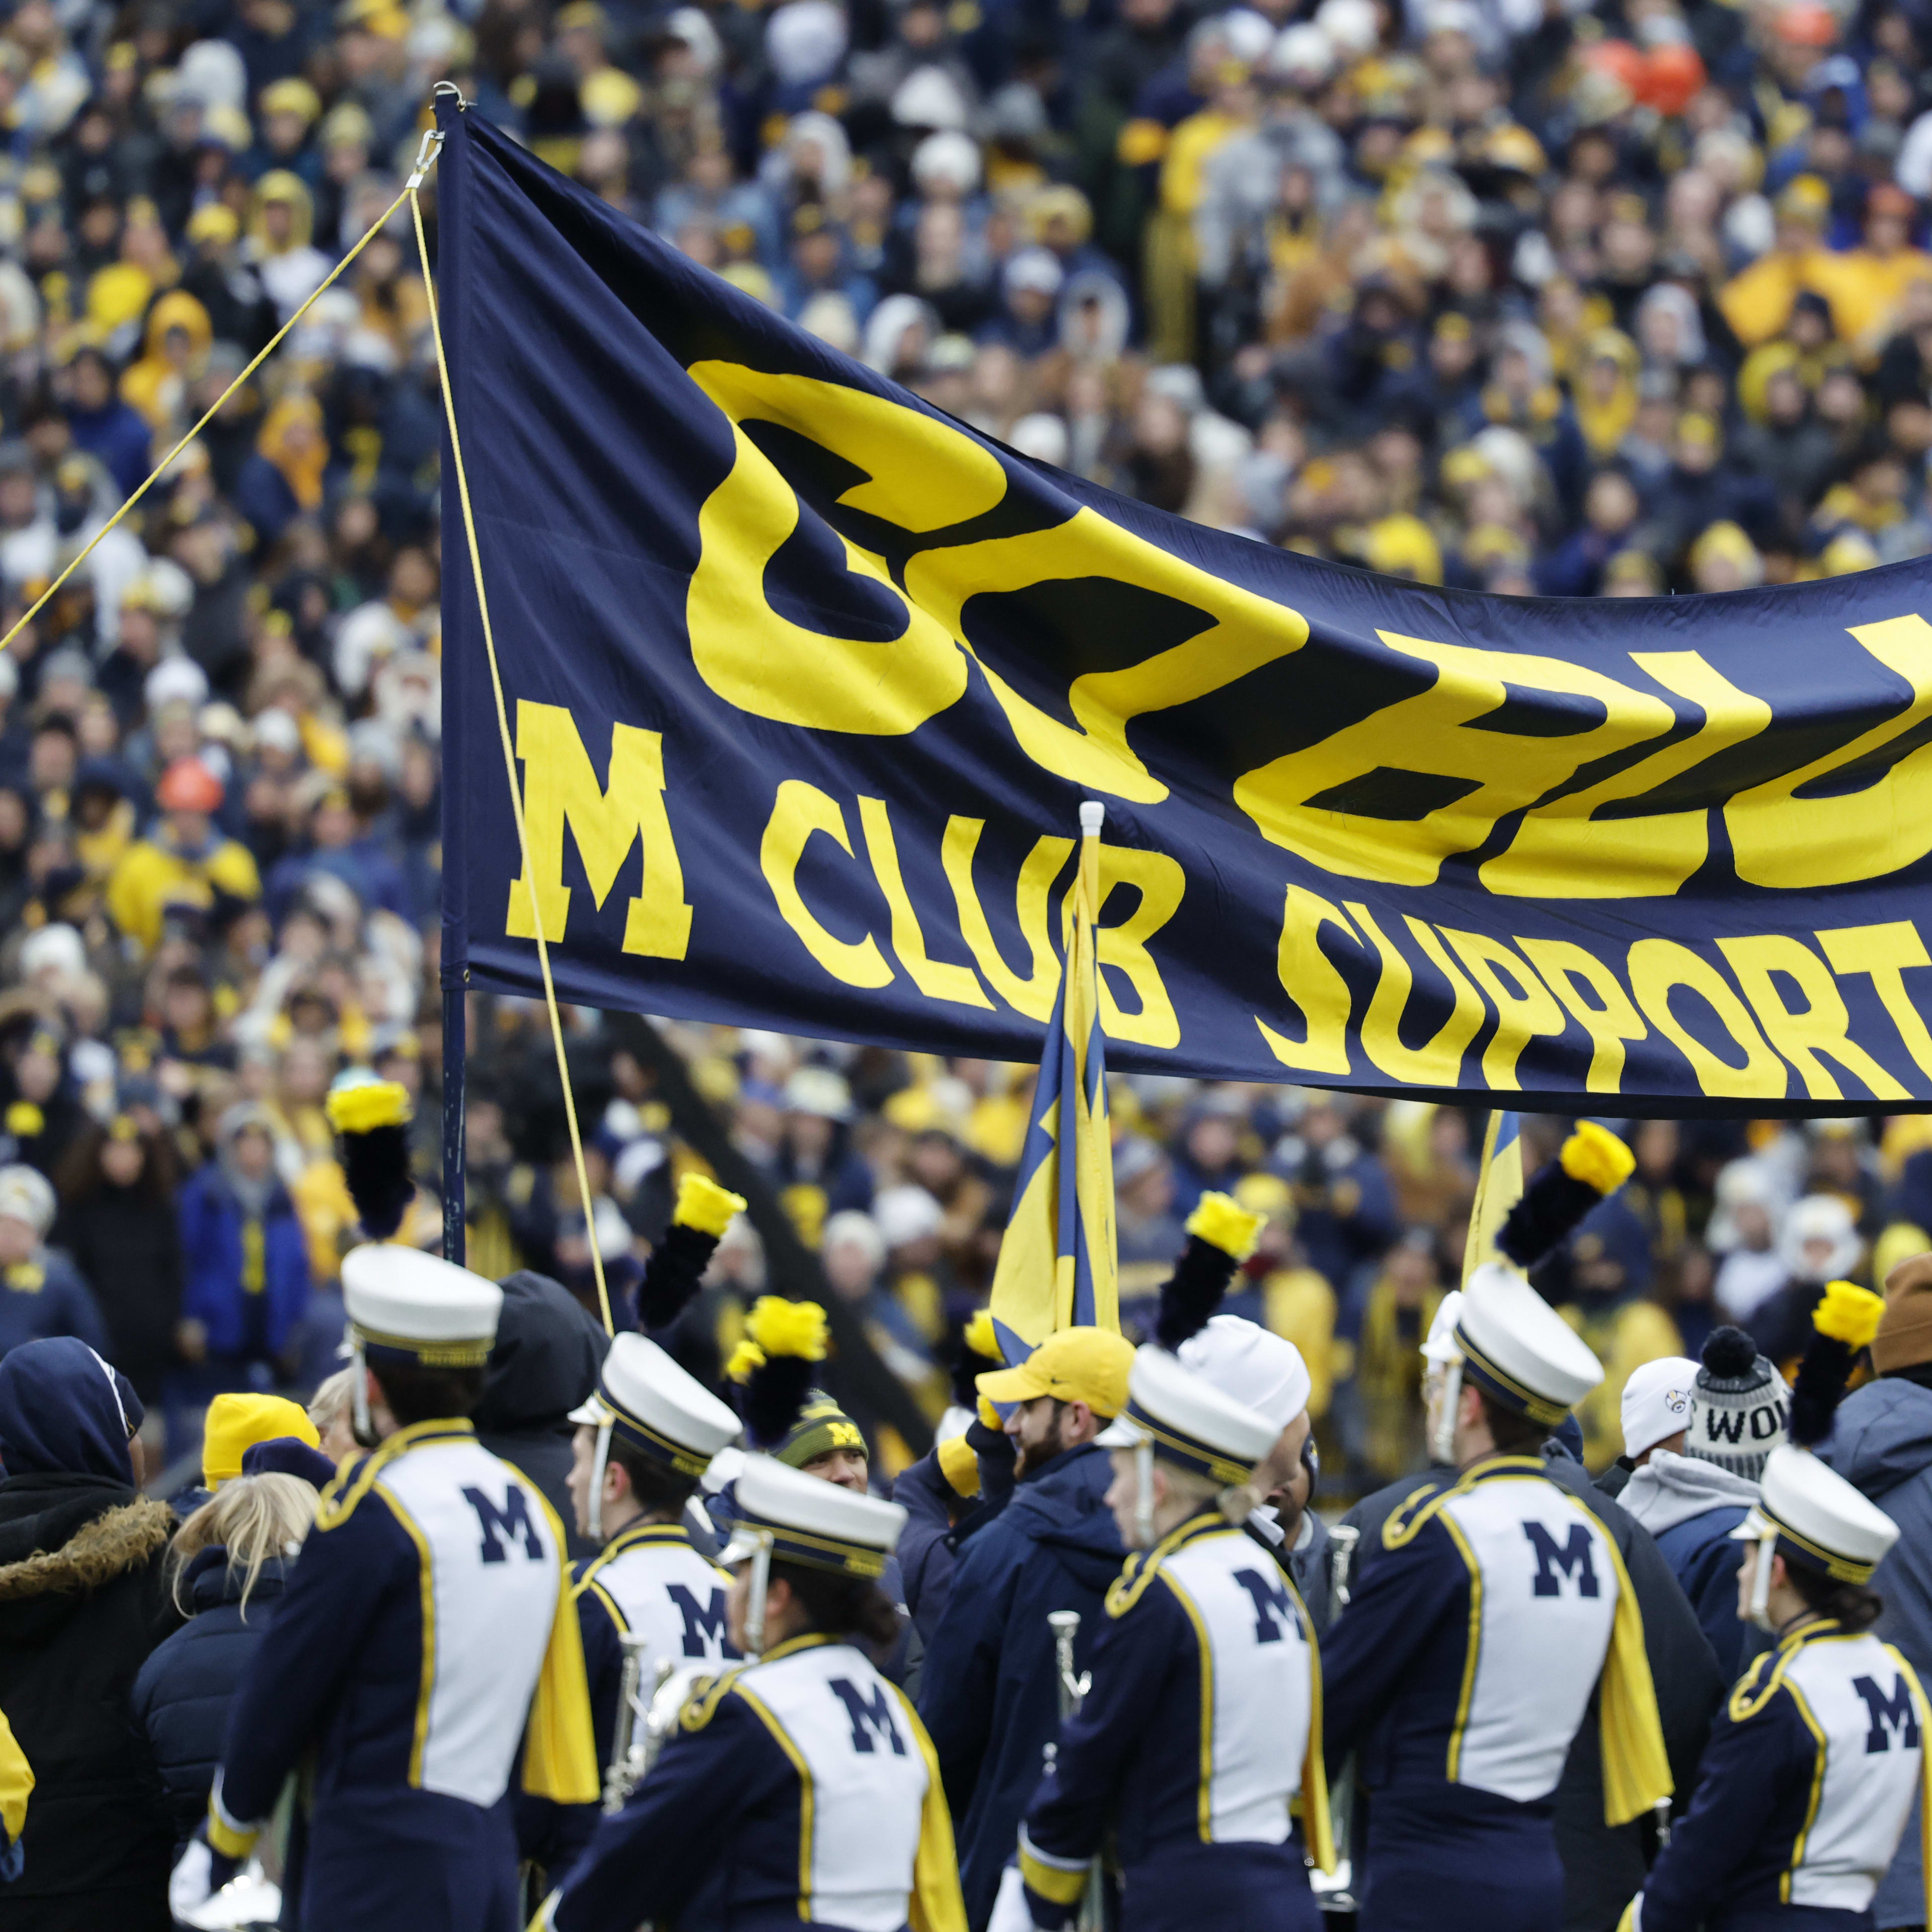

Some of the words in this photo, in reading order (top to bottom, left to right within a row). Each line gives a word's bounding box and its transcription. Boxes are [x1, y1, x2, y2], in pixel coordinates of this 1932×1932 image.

[506, 698, 694, 961] M
[760, 779, 1186, 1050] CLUB
[1254, 883, 1932, 1101] SUPPORT
[826, 1422, 861, 1445] M
[462, 1483, 544, 1563] M
[1522, 1521, 1599, 1598] M
[665, 1584, 745, 1661] M
[1232, 1569, 1308, 1643] M
[828, 1678, 907, 1755] M
[1852, 1672, 1919, 1753] M
